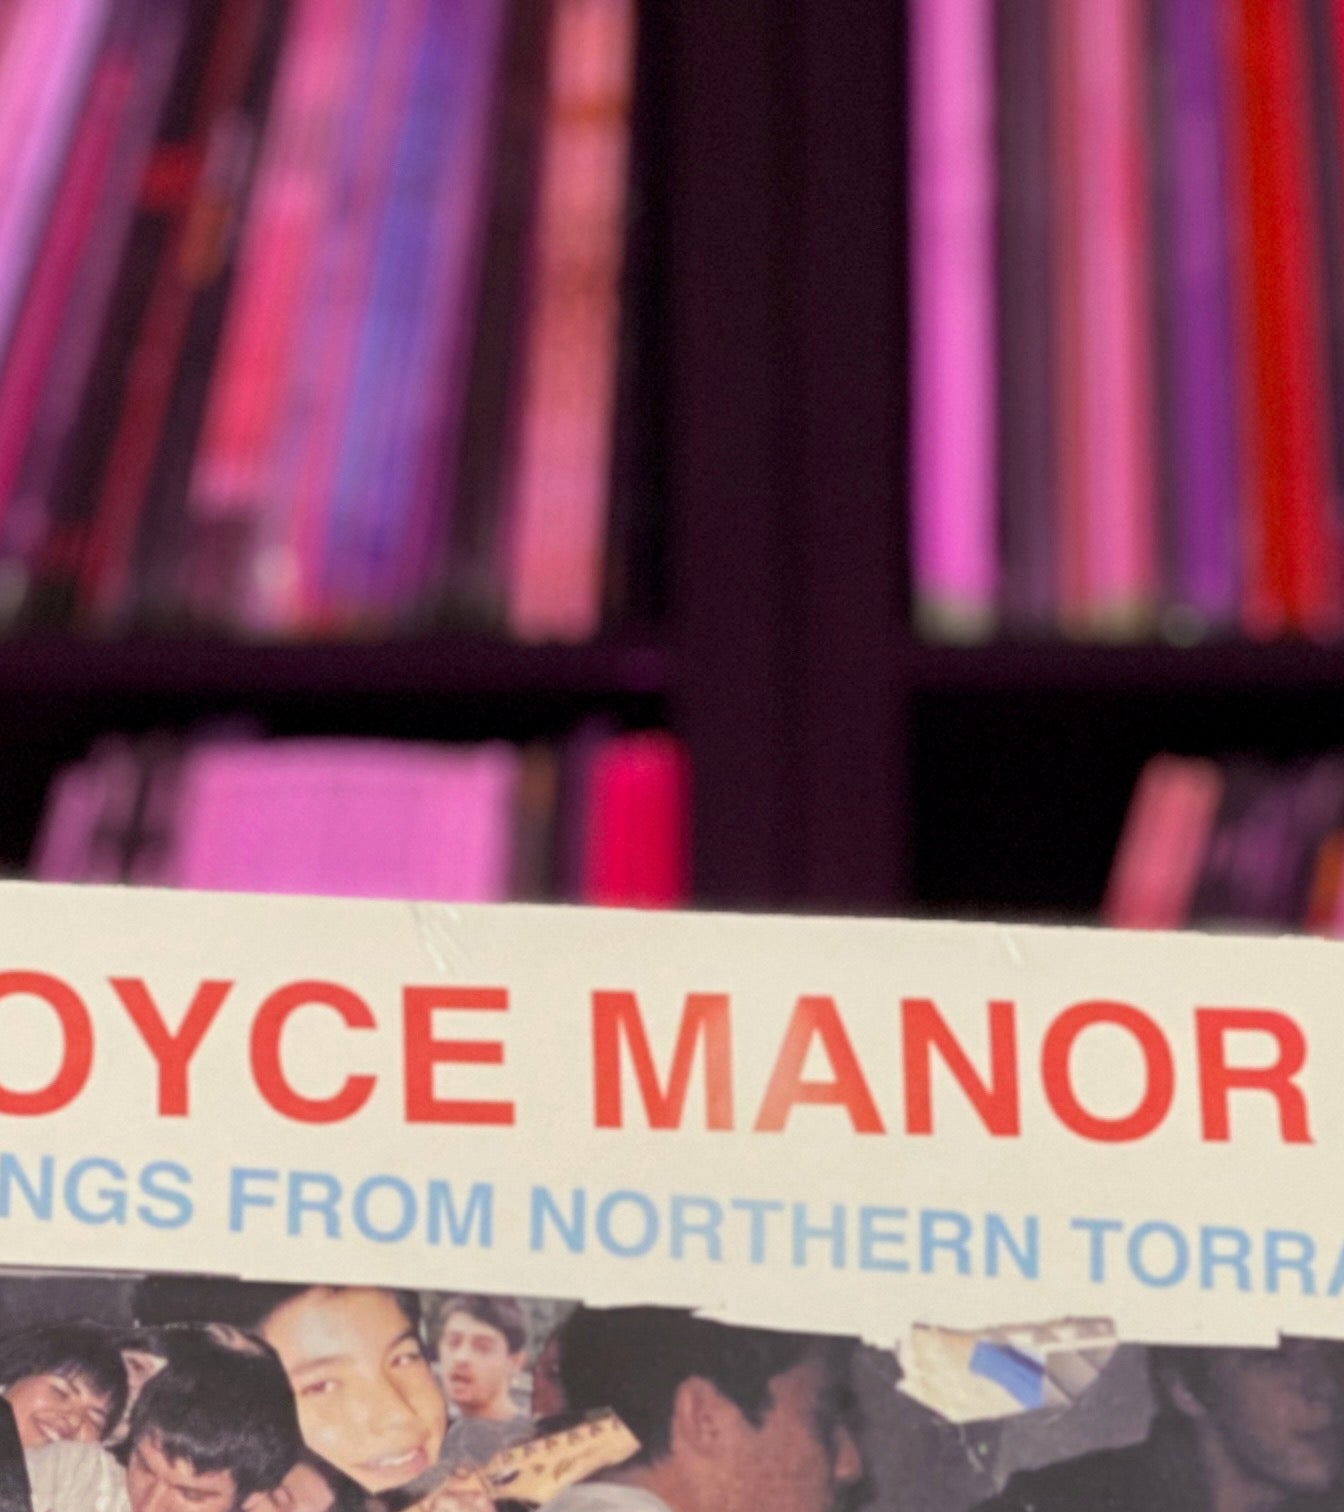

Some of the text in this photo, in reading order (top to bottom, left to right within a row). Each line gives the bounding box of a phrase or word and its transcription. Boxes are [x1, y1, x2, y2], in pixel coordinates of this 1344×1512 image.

[590, 987, 1315, 1147] MANOR
[227, 1164, 495, 1250] FROM
[528, 1184, 1041, 1281] NORTHERN
